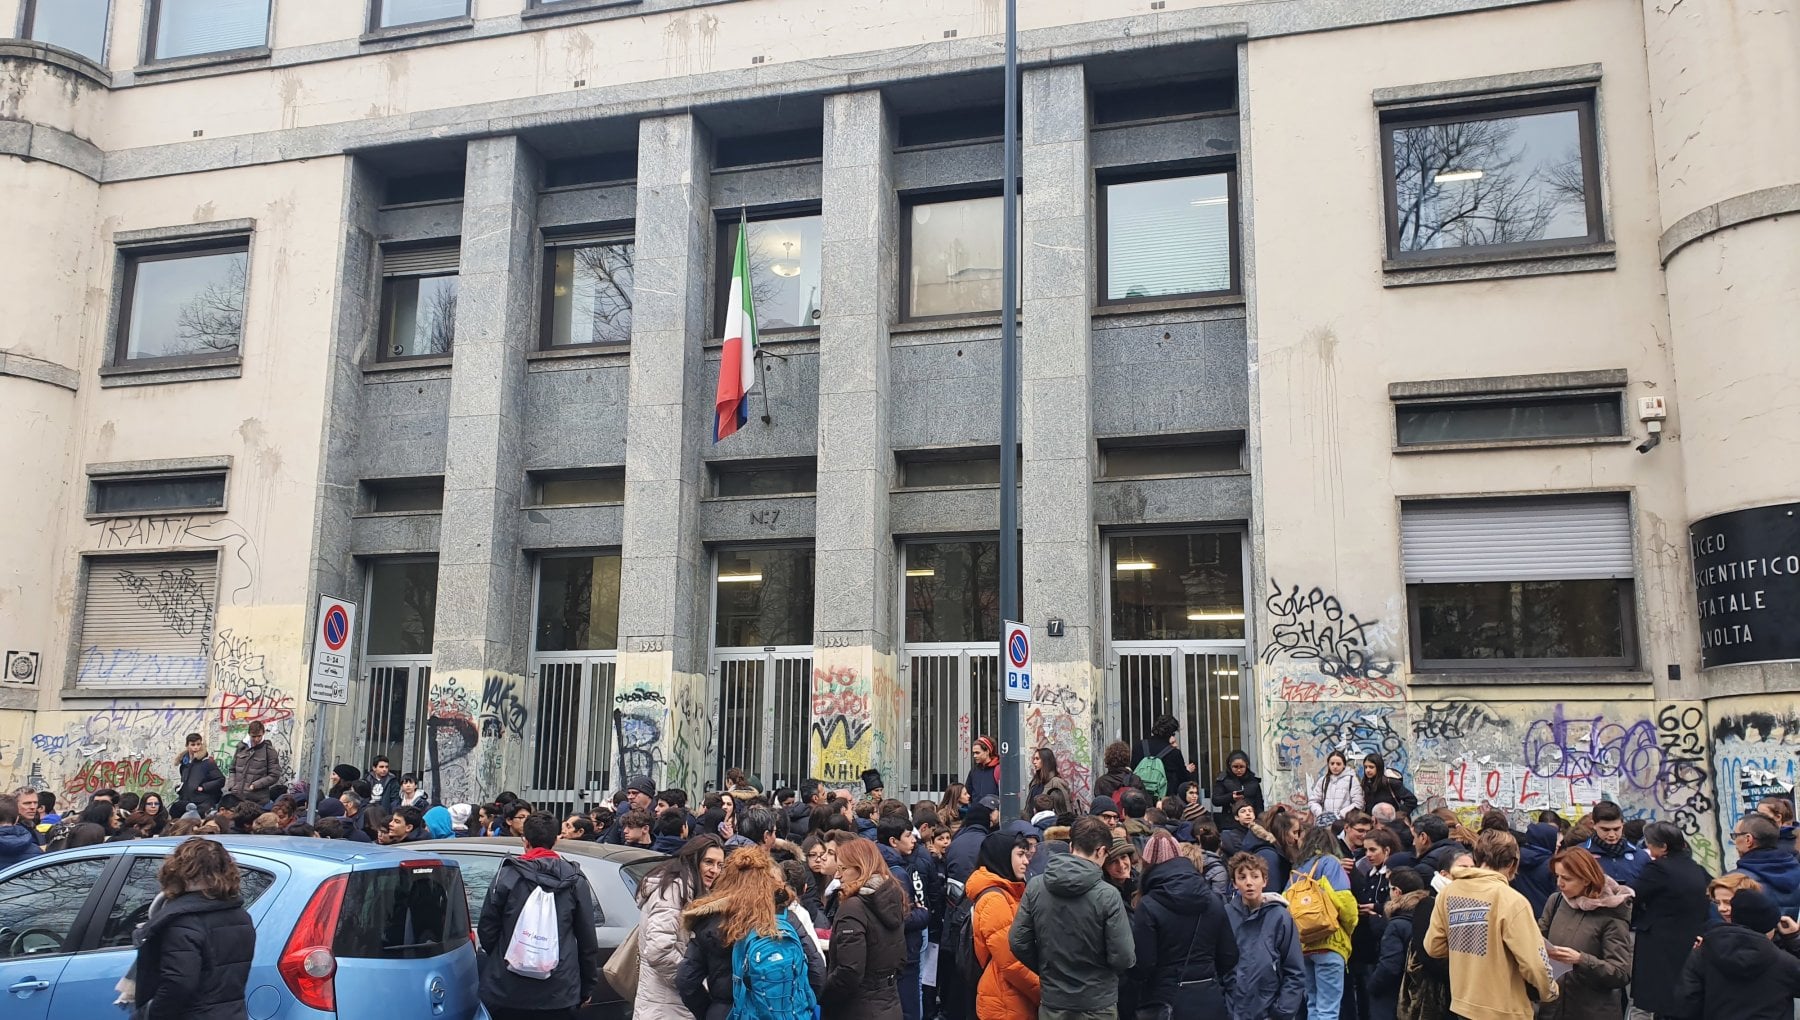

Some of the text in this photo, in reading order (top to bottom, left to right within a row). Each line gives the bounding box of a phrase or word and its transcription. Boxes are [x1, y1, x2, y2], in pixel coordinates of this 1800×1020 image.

[1696, 555, 1800, 590] SCIENTIFICO
[1698, 591, 1766, 619] STATALE
[1052, 621, 1059, 633] 7
[639, 641, 662, 652] 1936
[824, 637, 849, 647] 1936
[1659, 705, 1703, 731] 60
[1001, 742, 1009, 754] 9
[1660, 733, 1704, 755] 72
